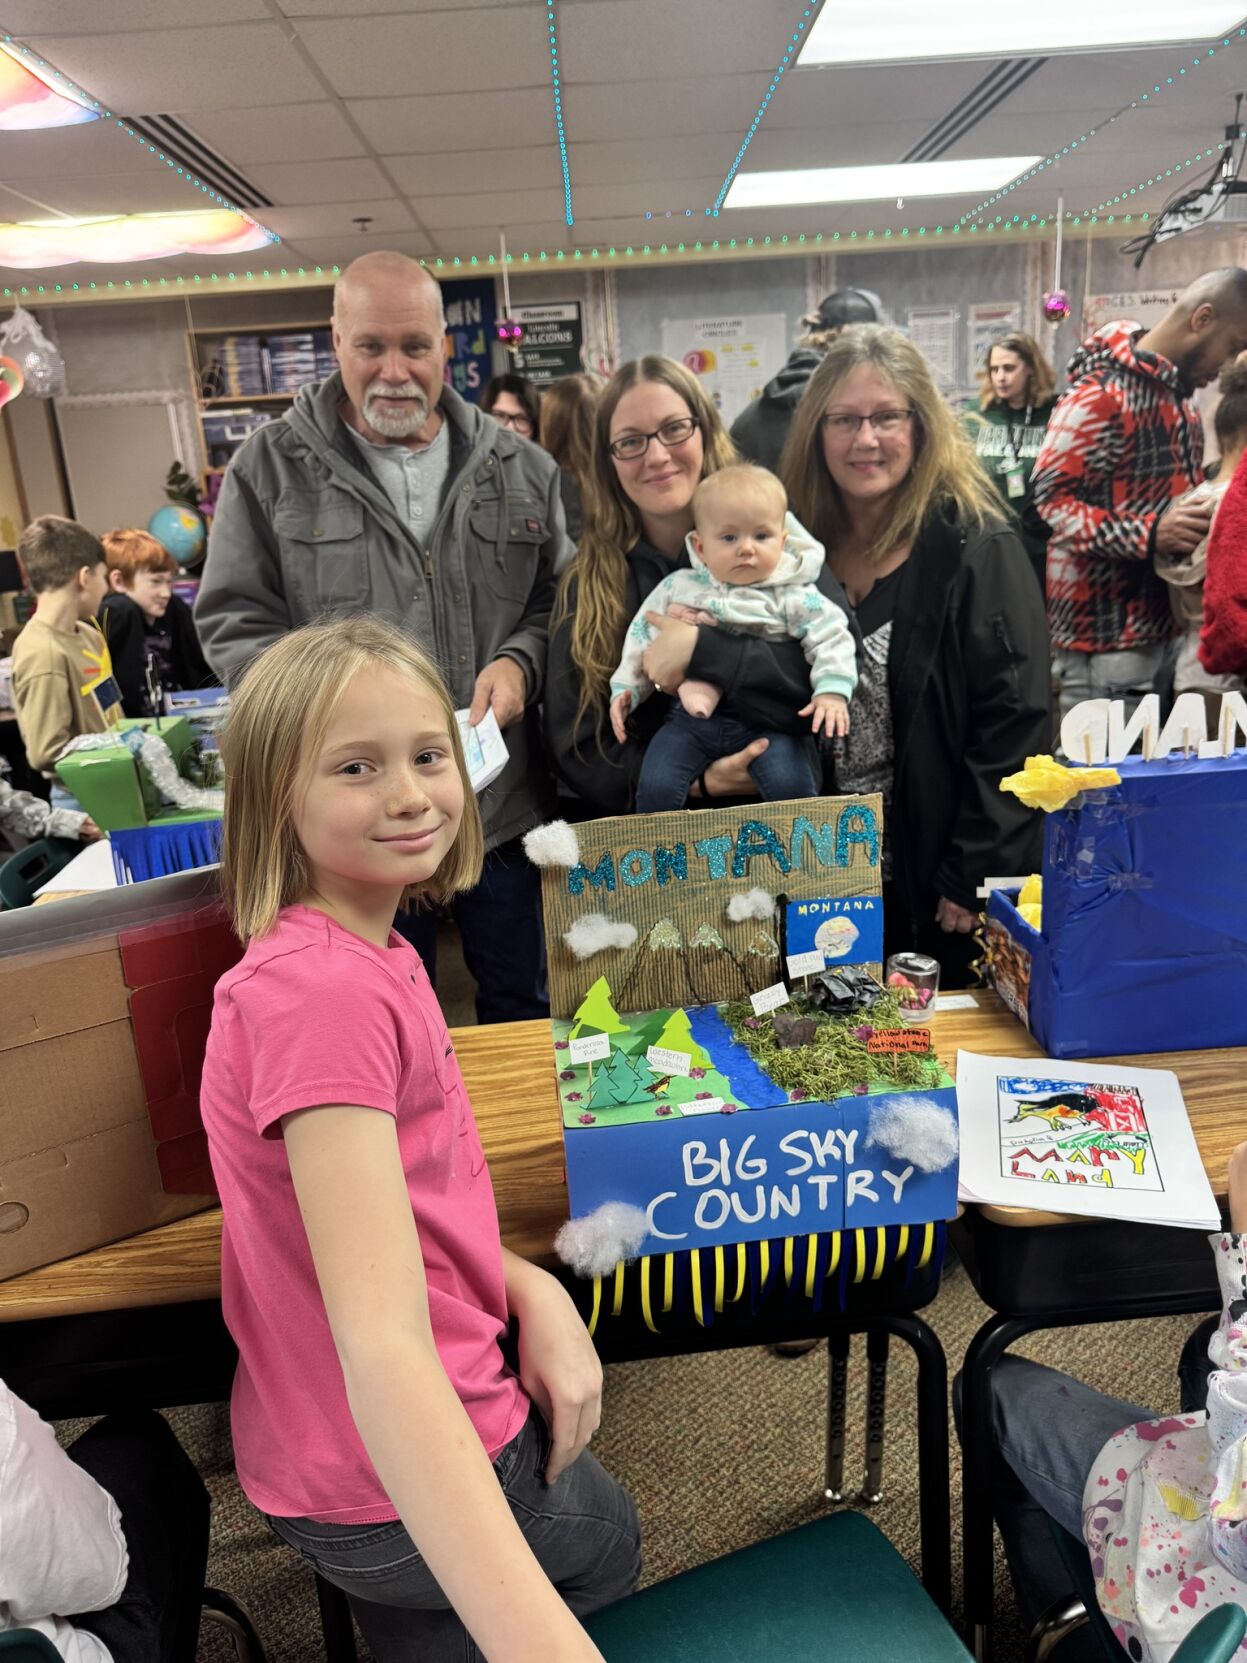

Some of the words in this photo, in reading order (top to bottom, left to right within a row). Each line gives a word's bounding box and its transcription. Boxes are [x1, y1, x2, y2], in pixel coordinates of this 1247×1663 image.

[567, 804, 880, 896] MONTANA
[798, 900, 875, 916] MONTANA
[682, 1134, 768, 1186] BIG
[779, 1128, 859, 1176] SKY
[646, 1165, 914, 1240] COUNTRY
